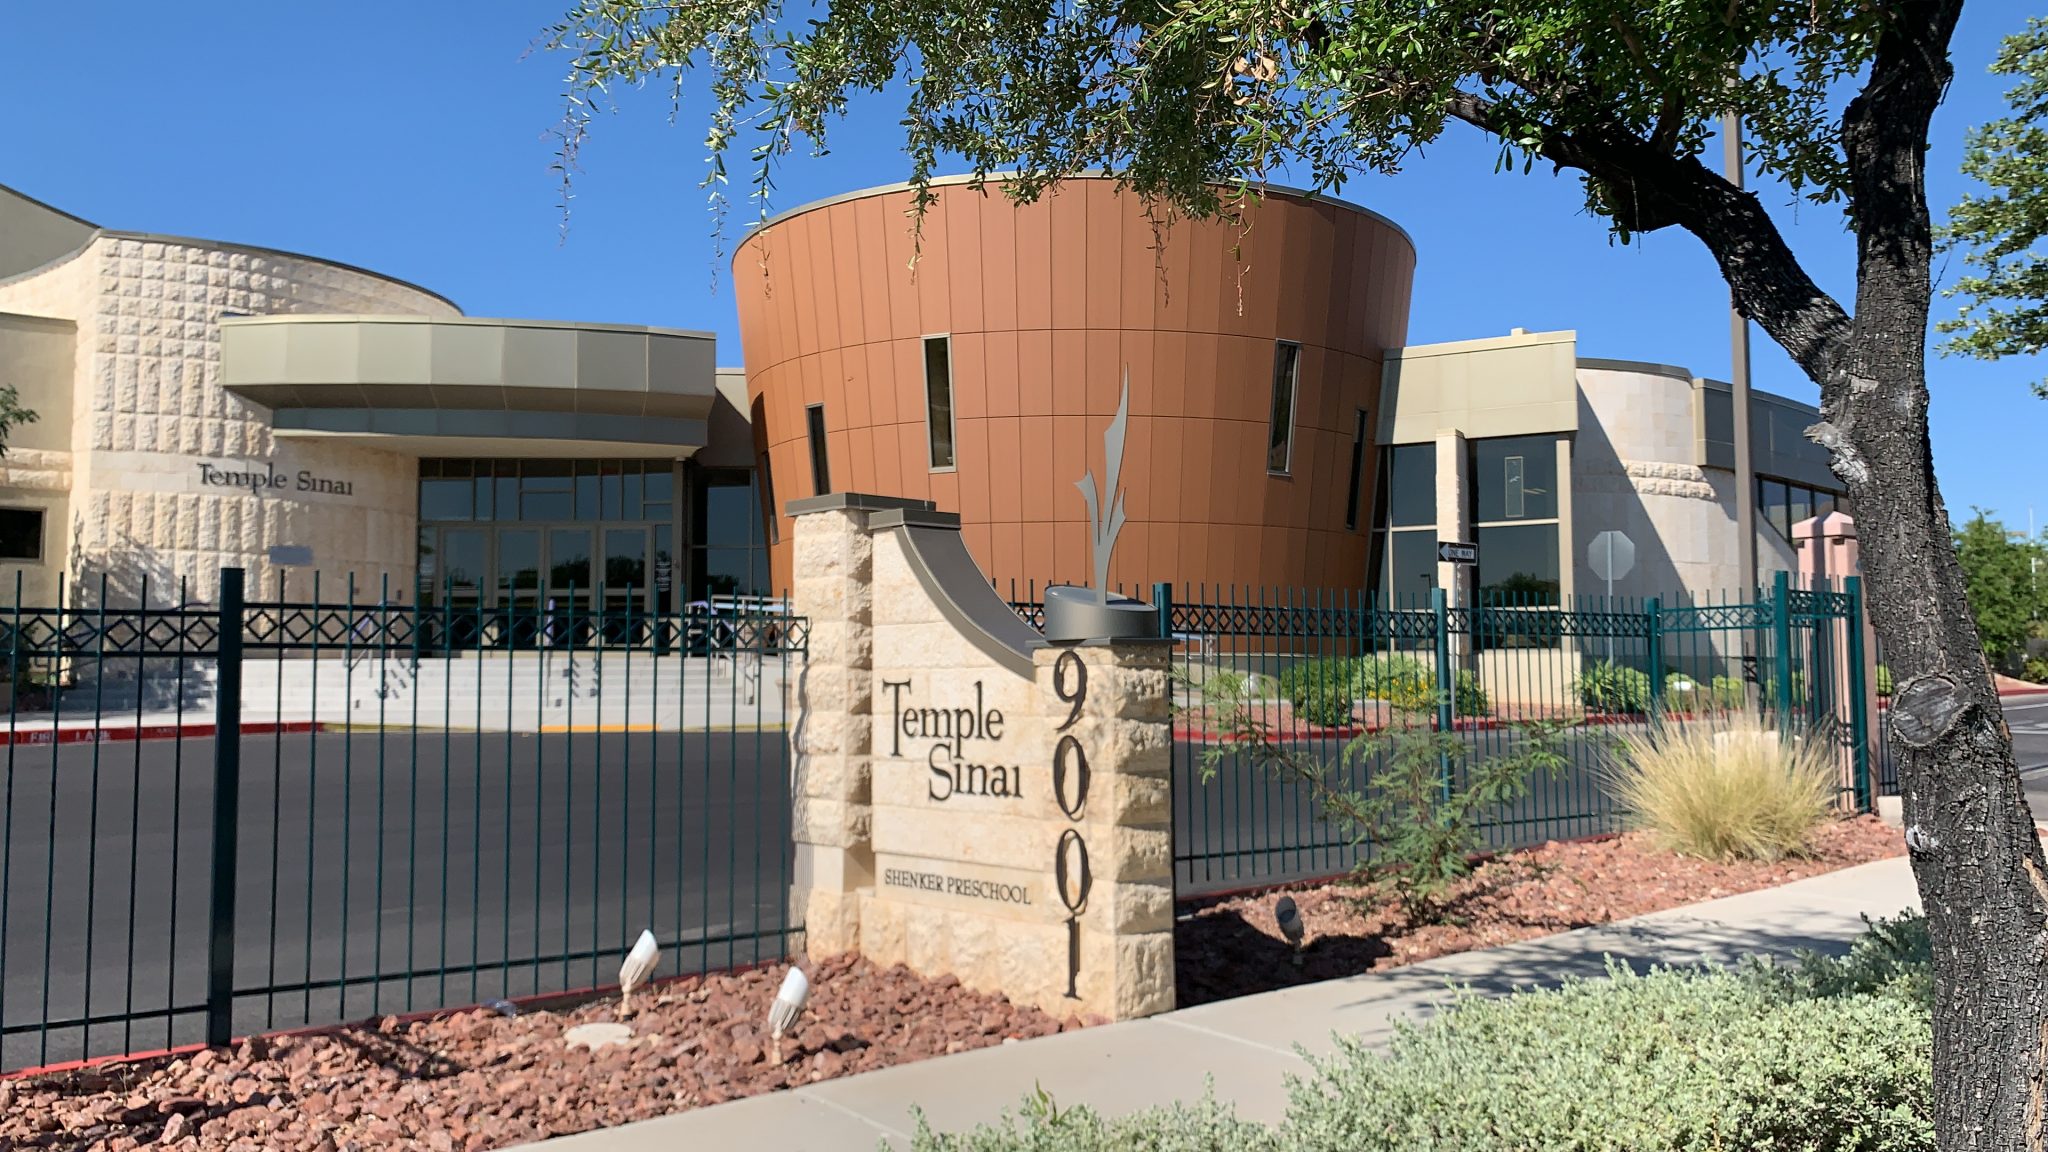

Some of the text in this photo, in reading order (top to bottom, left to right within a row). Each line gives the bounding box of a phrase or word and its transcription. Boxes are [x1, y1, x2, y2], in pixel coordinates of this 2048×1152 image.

[197, 462, 353, 496] Temple Sinai
[1461, 549, 1473, 558] WAY
[882, 678, 1004, 759] Temple
[928, 741, 1024, 802] Sinai
[1053, 650, 1093, 1001] 9001
[884, 868, 1032, 905] SHENKER PRESCHOOL
